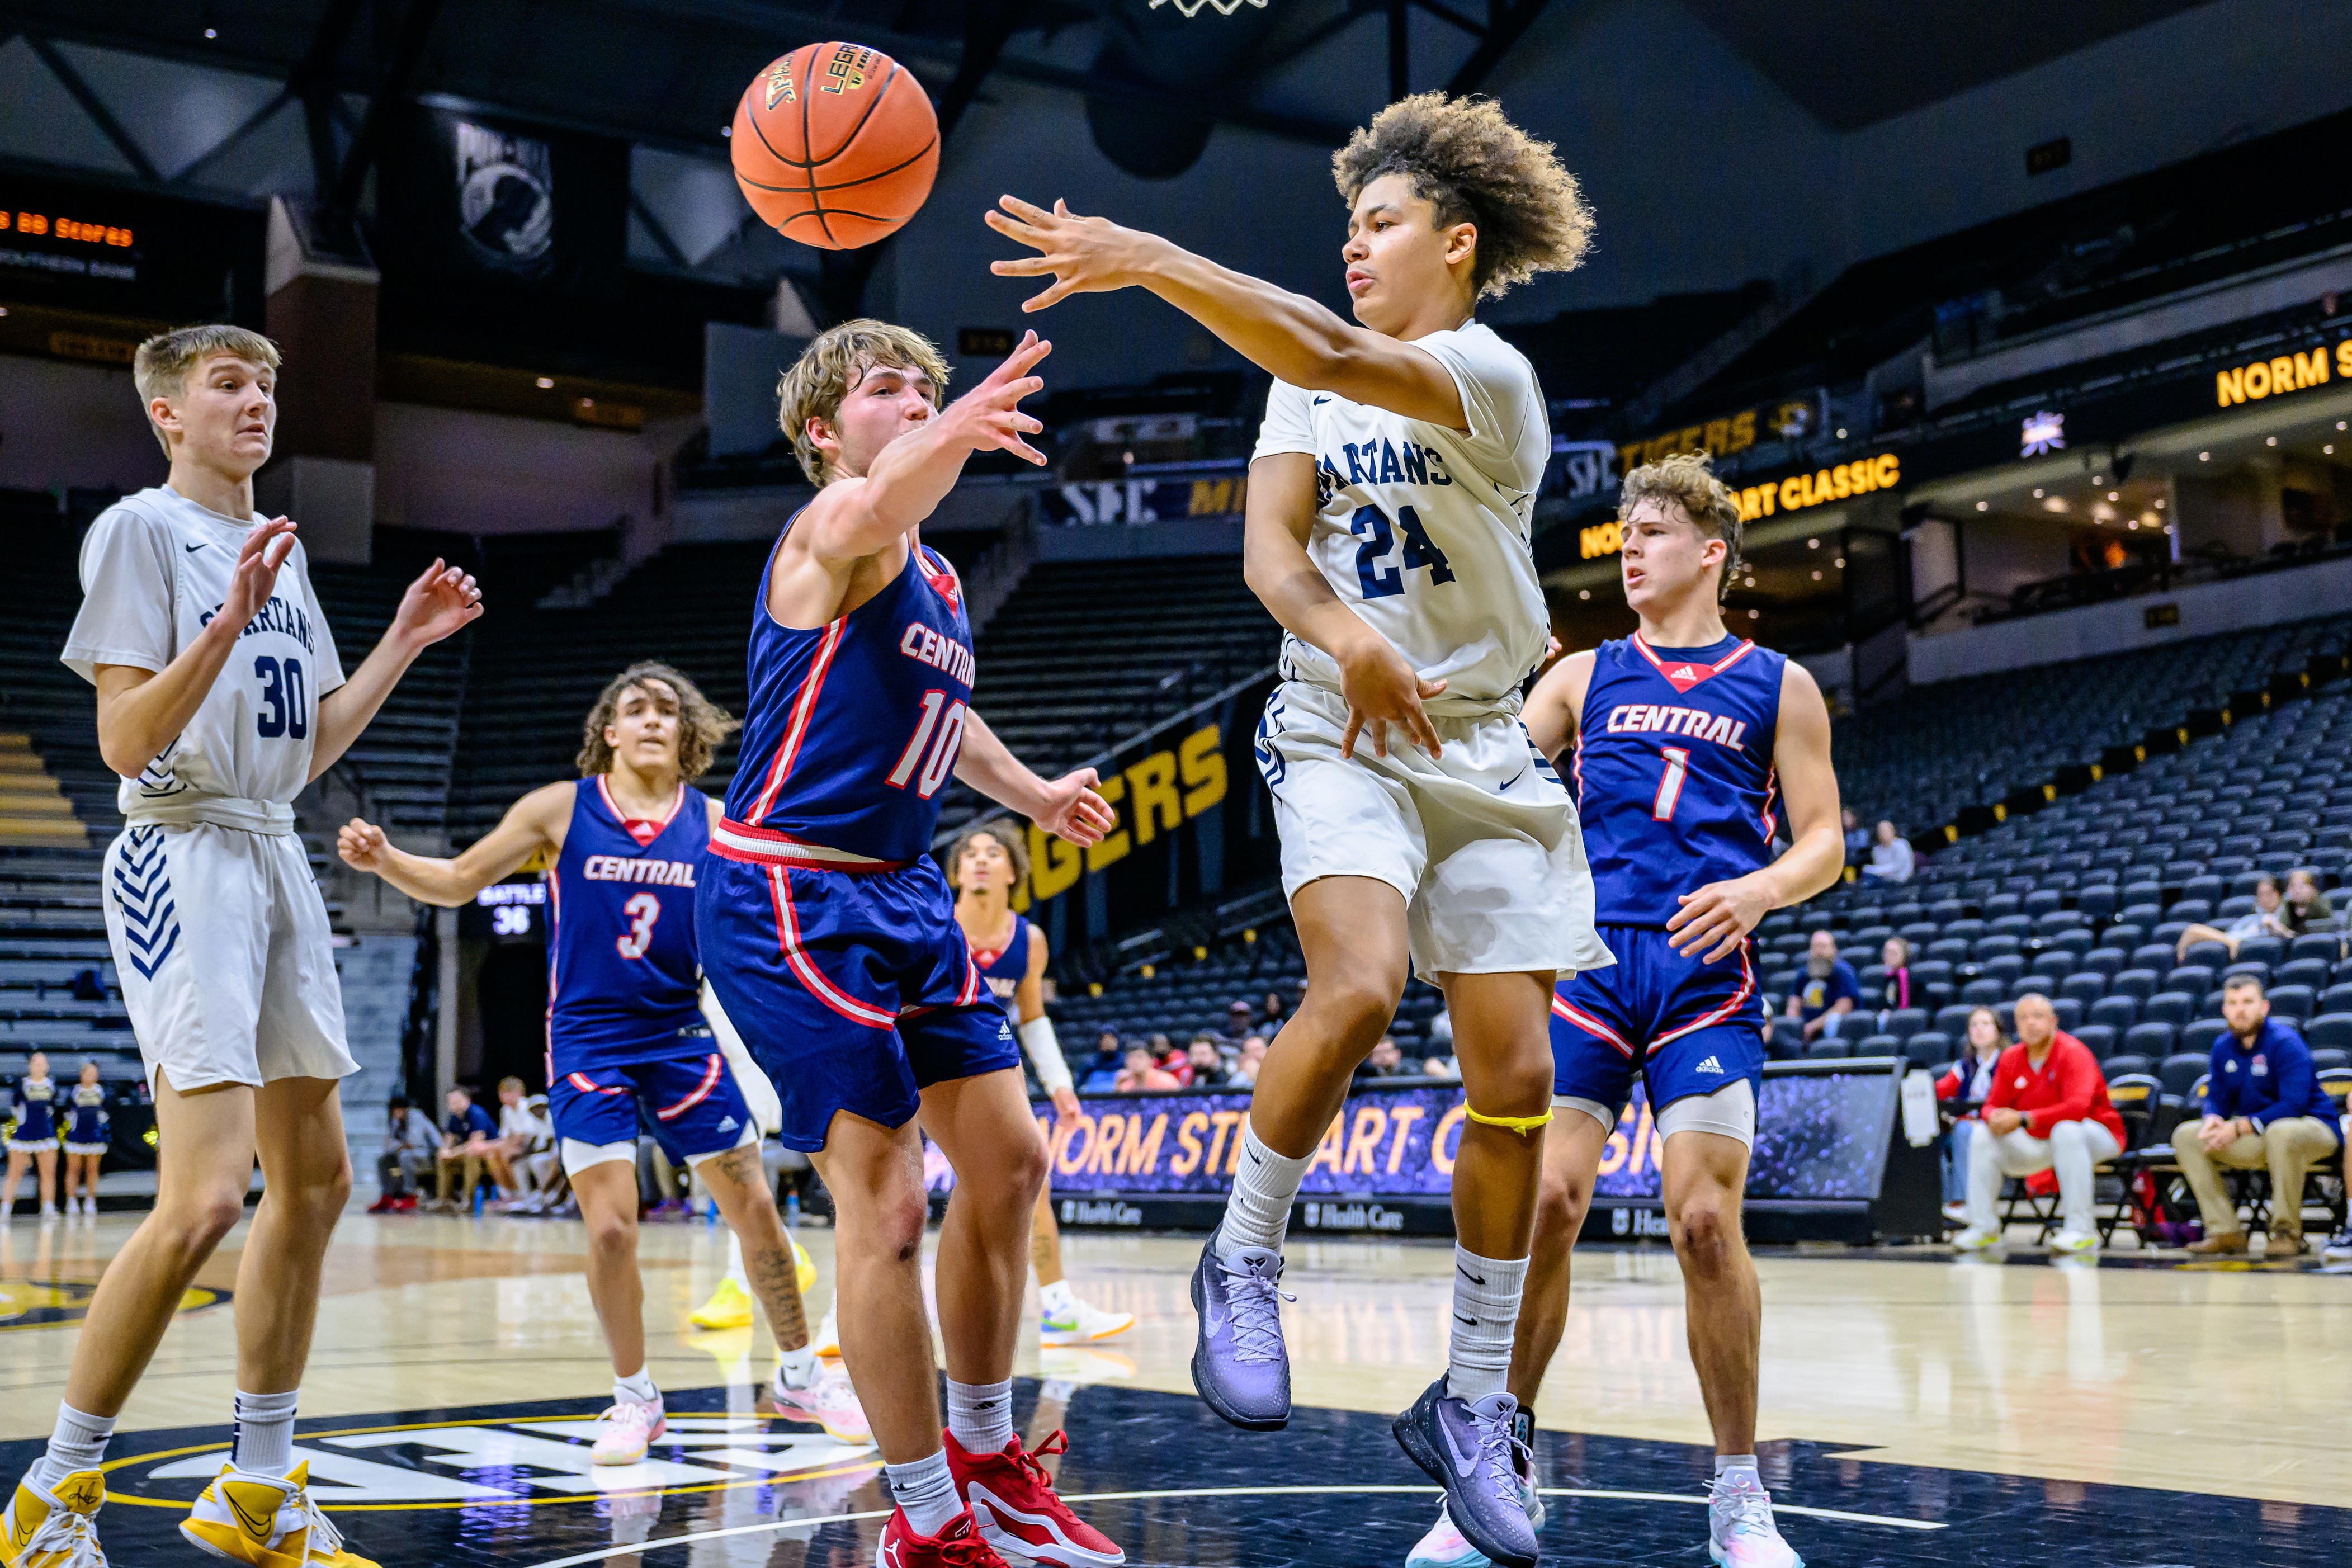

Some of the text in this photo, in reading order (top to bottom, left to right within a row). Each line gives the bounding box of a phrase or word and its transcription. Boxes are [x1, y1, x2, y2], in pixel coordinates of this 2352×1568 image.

[55, 218, 133, 247] Scores
[2216, 346, 2330, 407] NORM
[1779, 454, 1900, 511] CLASSIC
[1350, 503, 1456, 599] 24
[254, 655, 307, 740] 30
[1607, 704, 1746, 752] CENTRAL
[884, 688, 966, 800] 10
[1652, 747, 1690, 822] 1
[583, 855, 697, 888] CENTRAL
[616, 892, 662, 960] 3
[1695, 1065, 1725, 1074] adidas
[1037, 1112, 1169, 1176] NORM
